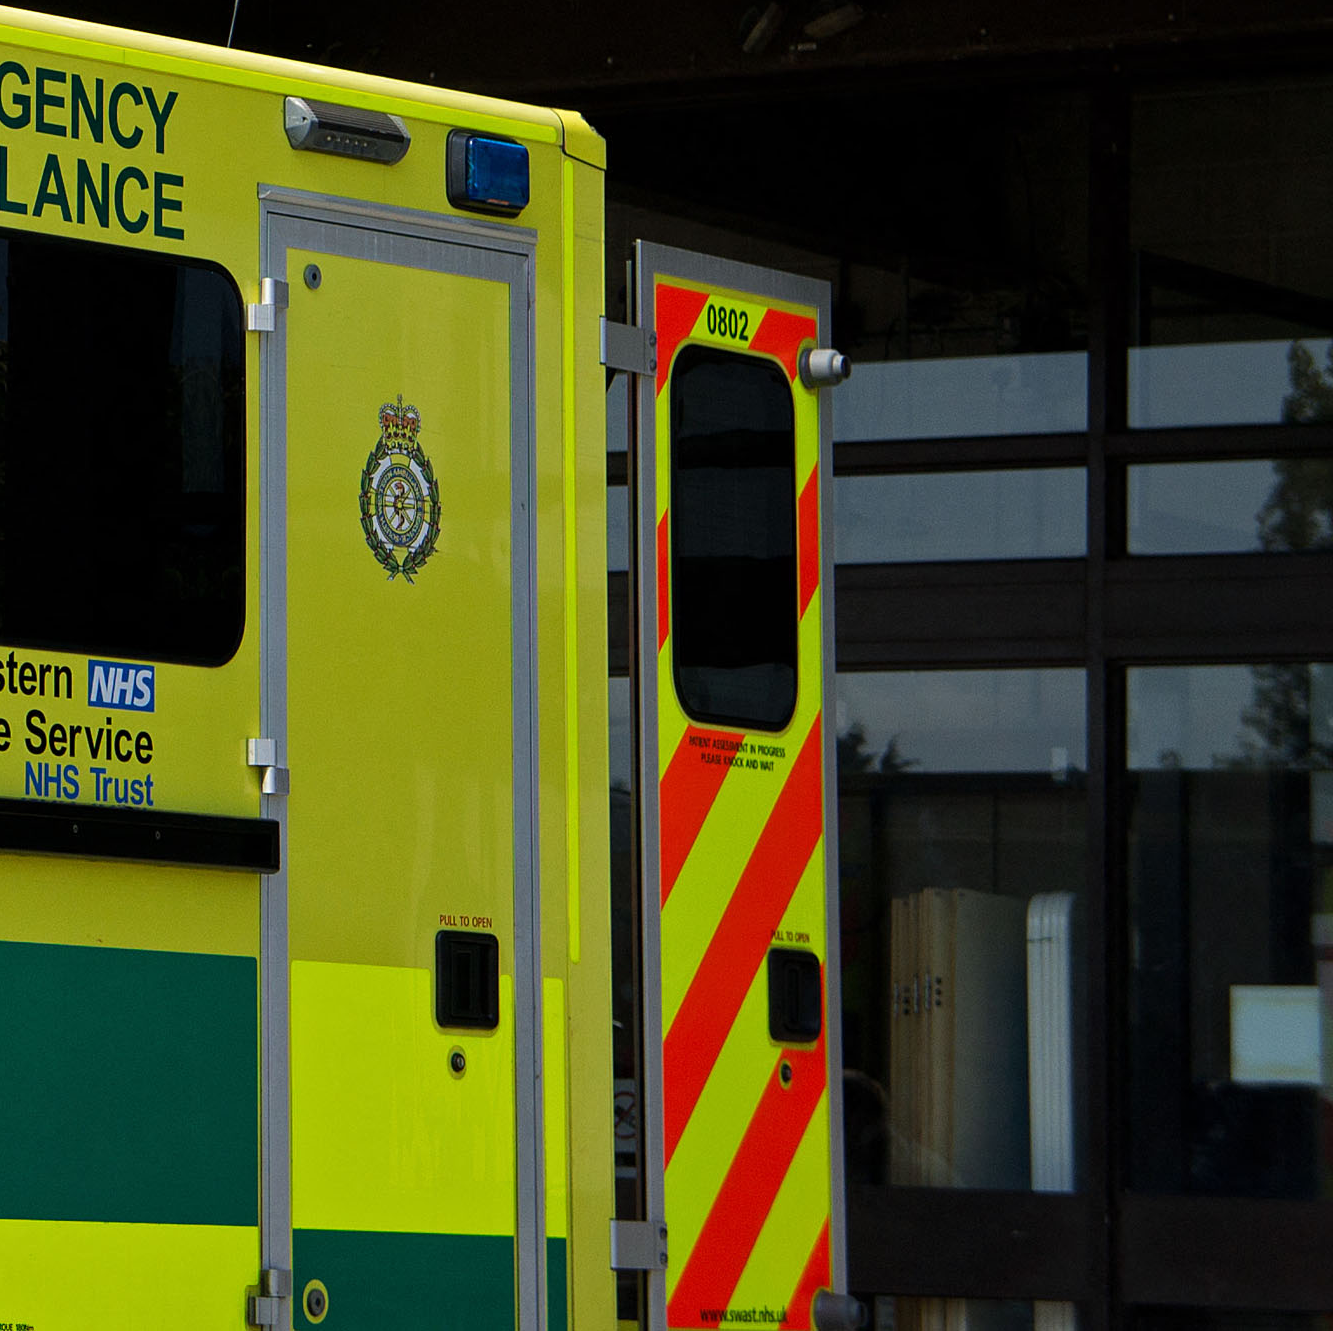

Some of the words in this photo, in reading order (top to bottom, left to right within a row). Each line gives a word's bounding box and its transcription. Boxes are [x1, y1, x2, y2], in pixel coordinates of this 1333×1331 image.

[706, 303, 749, 342] 0802
[90, 665, 153, 707] NHS
[24, 709, 154, 765] Service
[750, 744, 756, 754] IN
[758, 745, 786, 758] PROGRESS
[701, 753, 721, 765] PLEASE
[723, 755, 744, 767] KNOCK
[745, 759, 759, 770] AND
[760, 760, 774, 771] WAIT
[24, 760, 80, 800] NHS
[89, 766, 155, 807] Trust
[439, 914, 457, 926] PULL
[460, 915, 470, 927] TO
[472, 917, 492, 928] OPEN
[700, 1305, 788, 1324] www.swast.nhs.uk
